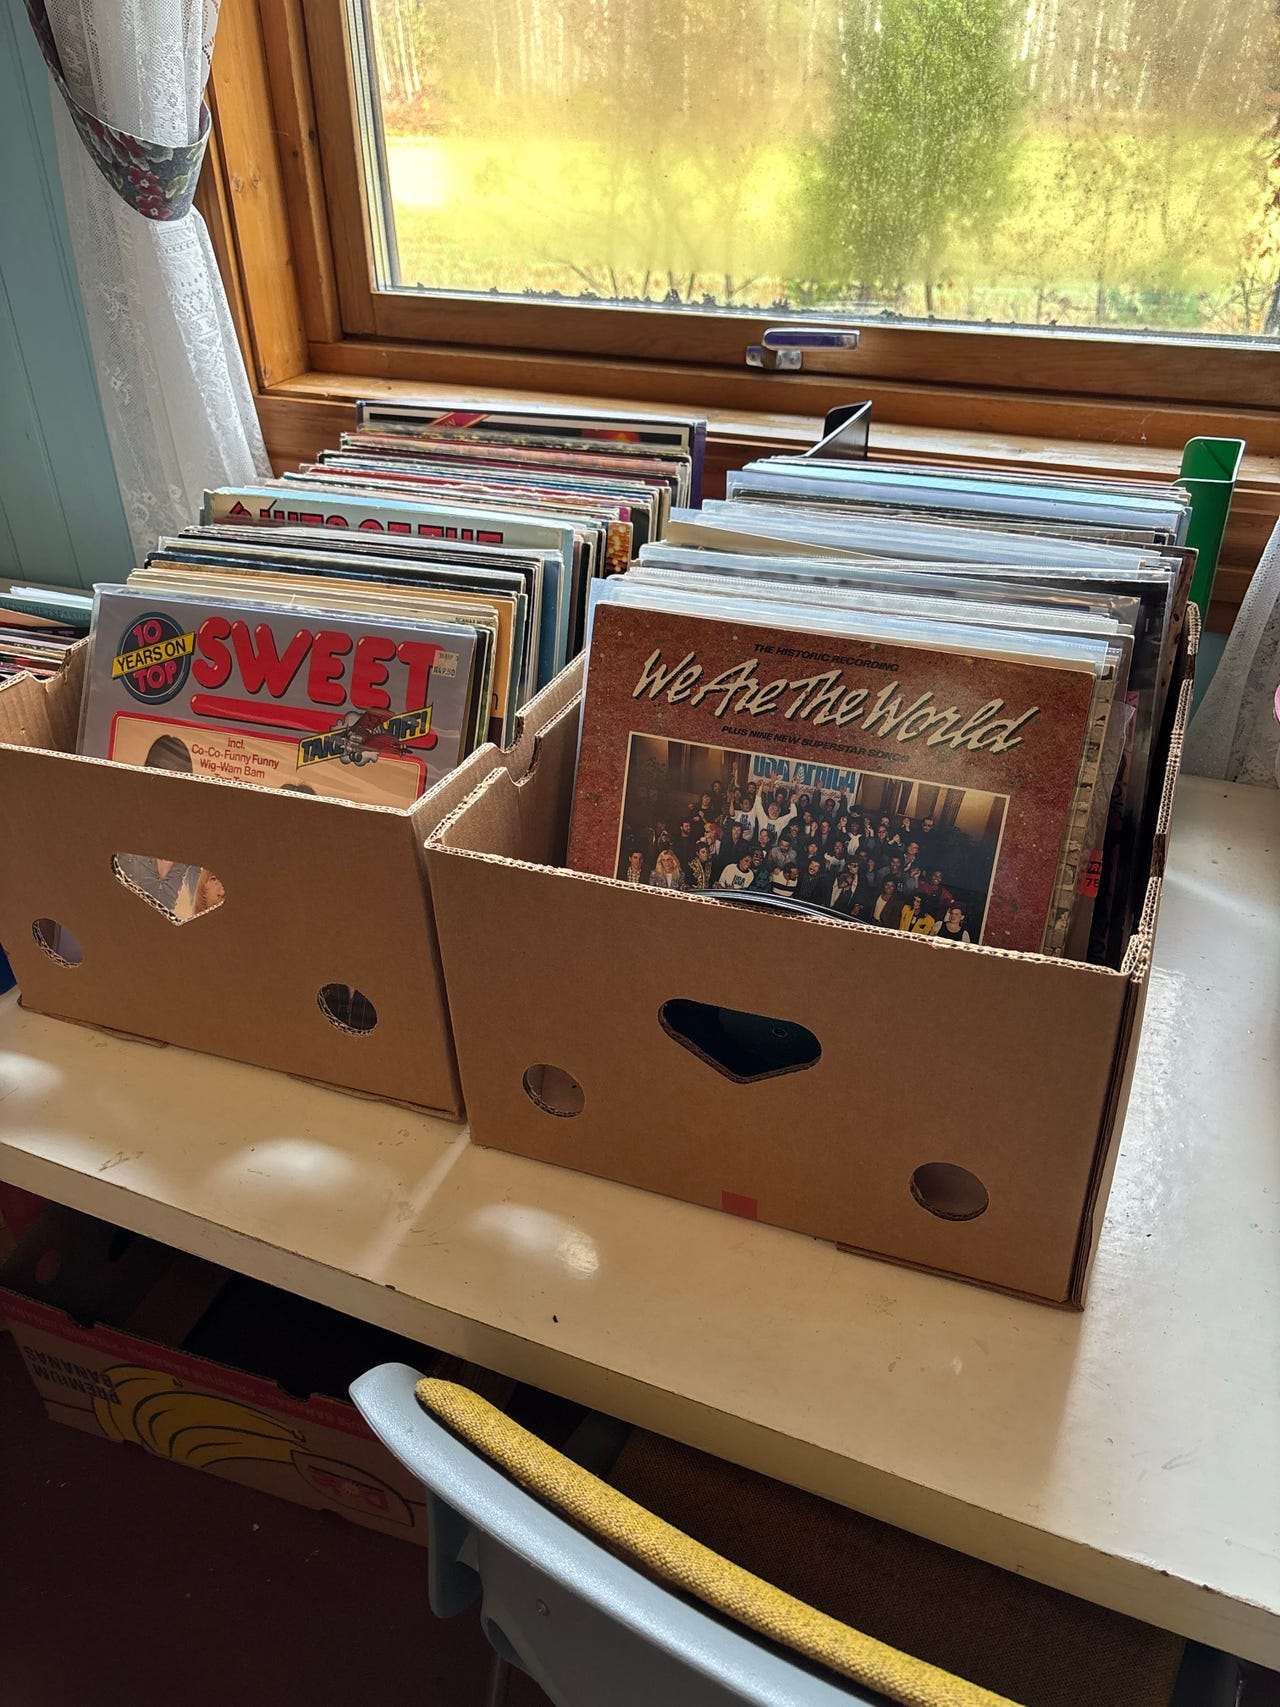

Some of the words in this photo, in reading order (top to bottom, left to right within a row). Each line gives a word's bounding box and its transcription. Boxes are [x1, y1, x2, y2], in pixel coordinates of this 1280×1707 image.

[133, 620, 162, 647] 10
[117, 646, 162, 671] YEARS
[164, 638, 186, 657] ON
[192, 616, 445, 712] SWEET
[754, 643, 774, 654] THE
[776, 647, 830, 662] HISTORIC
[831, 655, 899, 672] RECORDING
[133, 660, 177, 693] TOP
[632, 648, 703, 705] We
[691, 658, 788, 719] Are
[784, 669, 869, 728] The
[861, 680, 1040, 755] World
[227, 737, 246, 749] incl.
[721, 725, 748, 737] PLUS
[749, 729, 773, 741] NINE
[773, 734, 800, 744] NEW
[801, 738, 868, 756] SUPERSTAR
[867, 748, 910, 763] SONGS
[200, 758, 242, 774] Wig-Wam
[244, 766, 265, 779] Bam
[252, 754, 280, 770] Funny
[24, 1345, 117, 1391] BANANAS
[31, 1362, 121, 1405] PREMIUM
